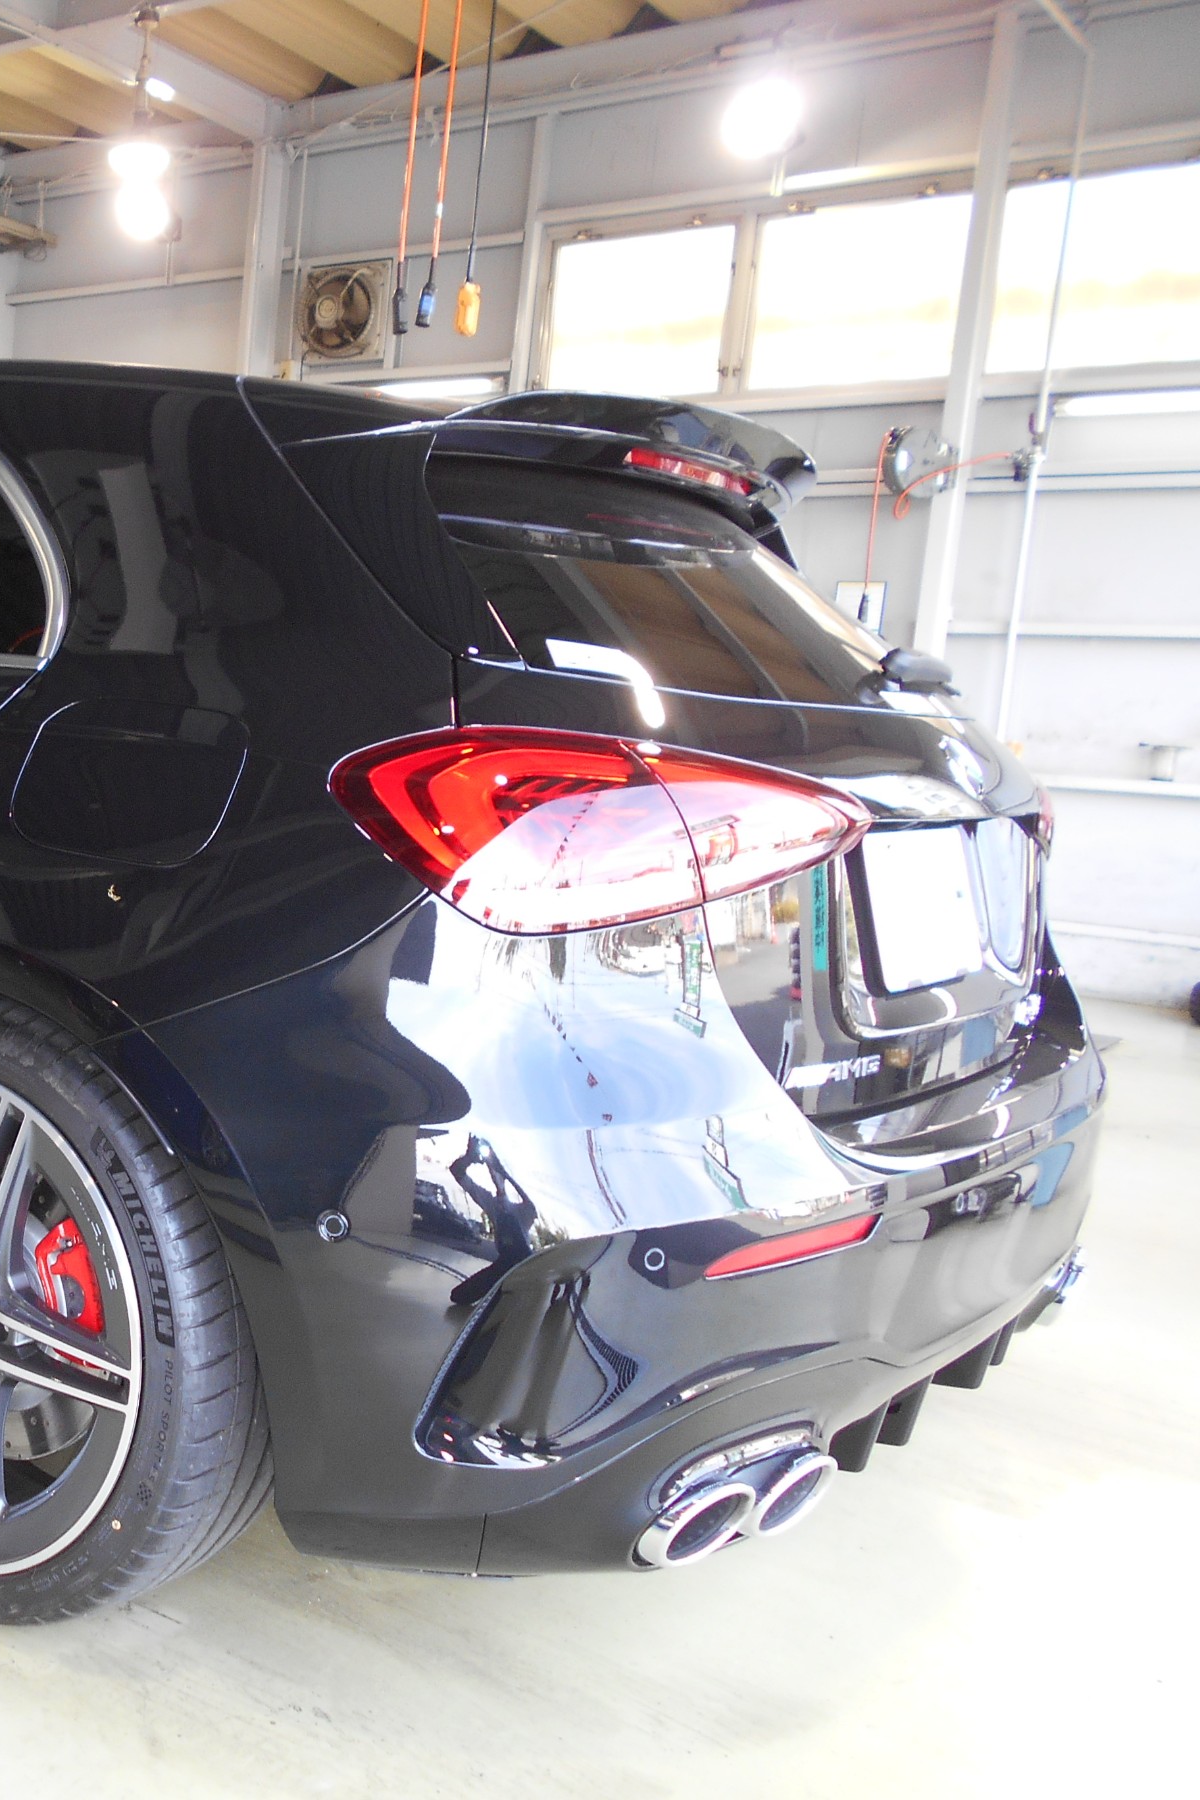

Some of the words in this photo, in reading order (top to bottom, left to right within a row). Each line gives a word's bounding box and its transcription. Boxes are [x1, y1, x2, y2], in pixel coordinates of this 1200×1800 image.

[827, 1054, 881, 1082] AMG
[111, 1171, 173, 1333] MICHELIN
[163, 1359, 174, 1406] PILOT
[156, 1410, 171, 1462] SPORT
